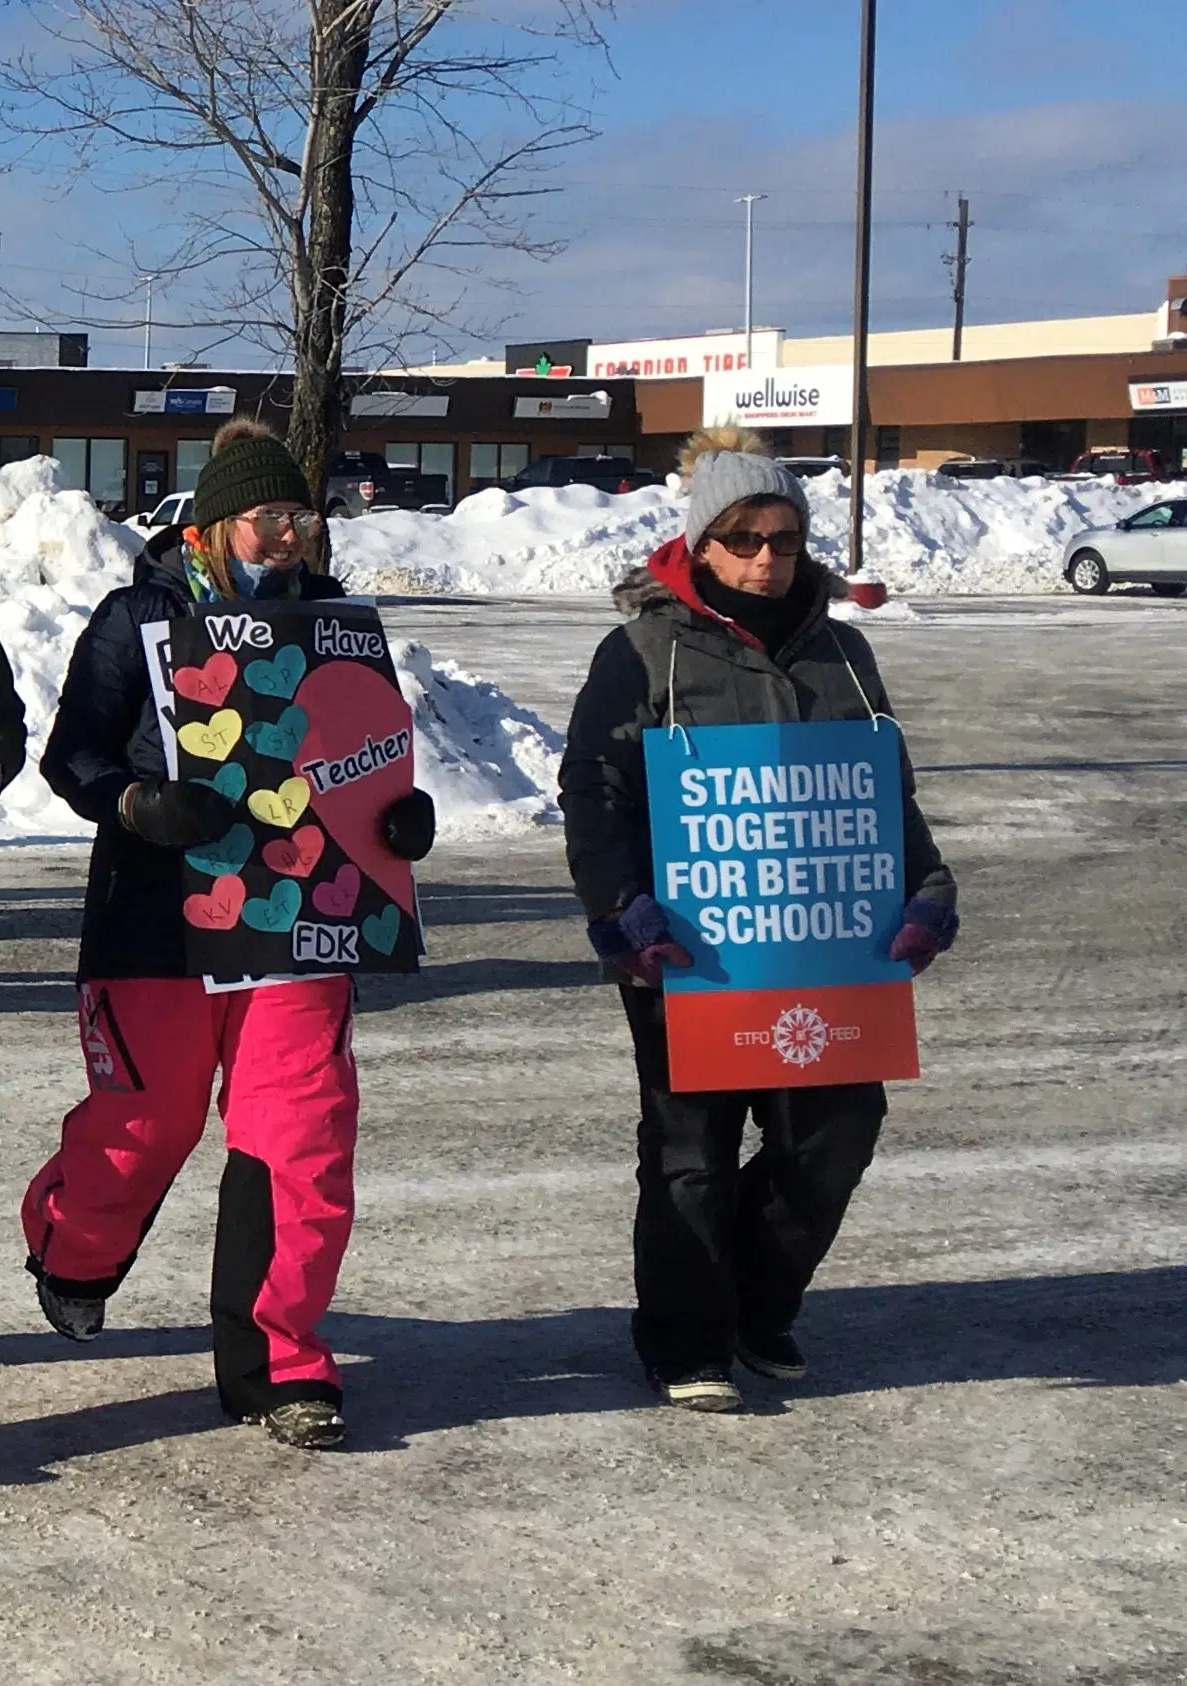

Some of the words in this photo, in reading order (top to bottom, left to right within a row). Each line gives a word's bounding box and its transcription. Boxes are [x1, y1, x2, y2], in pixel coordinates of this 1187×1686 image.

[735, 377, 820, 409] wellwise
[206, 615, 274, 650] We
[315, 619, 383, 657] Have
[302, 729, 410, 795] Teacher
[680, 761, 874, 807] STANDING
[680, 808, 878, 852] TOGETHER
[666, 859, 748, 900] FOR
[757, 852, 895, 896] BETTER
[294, 923, 359, 963] FDK
[699, 899, 873, 945] SCHOOLS
[734, 1031, 770, 1046] ETFO
